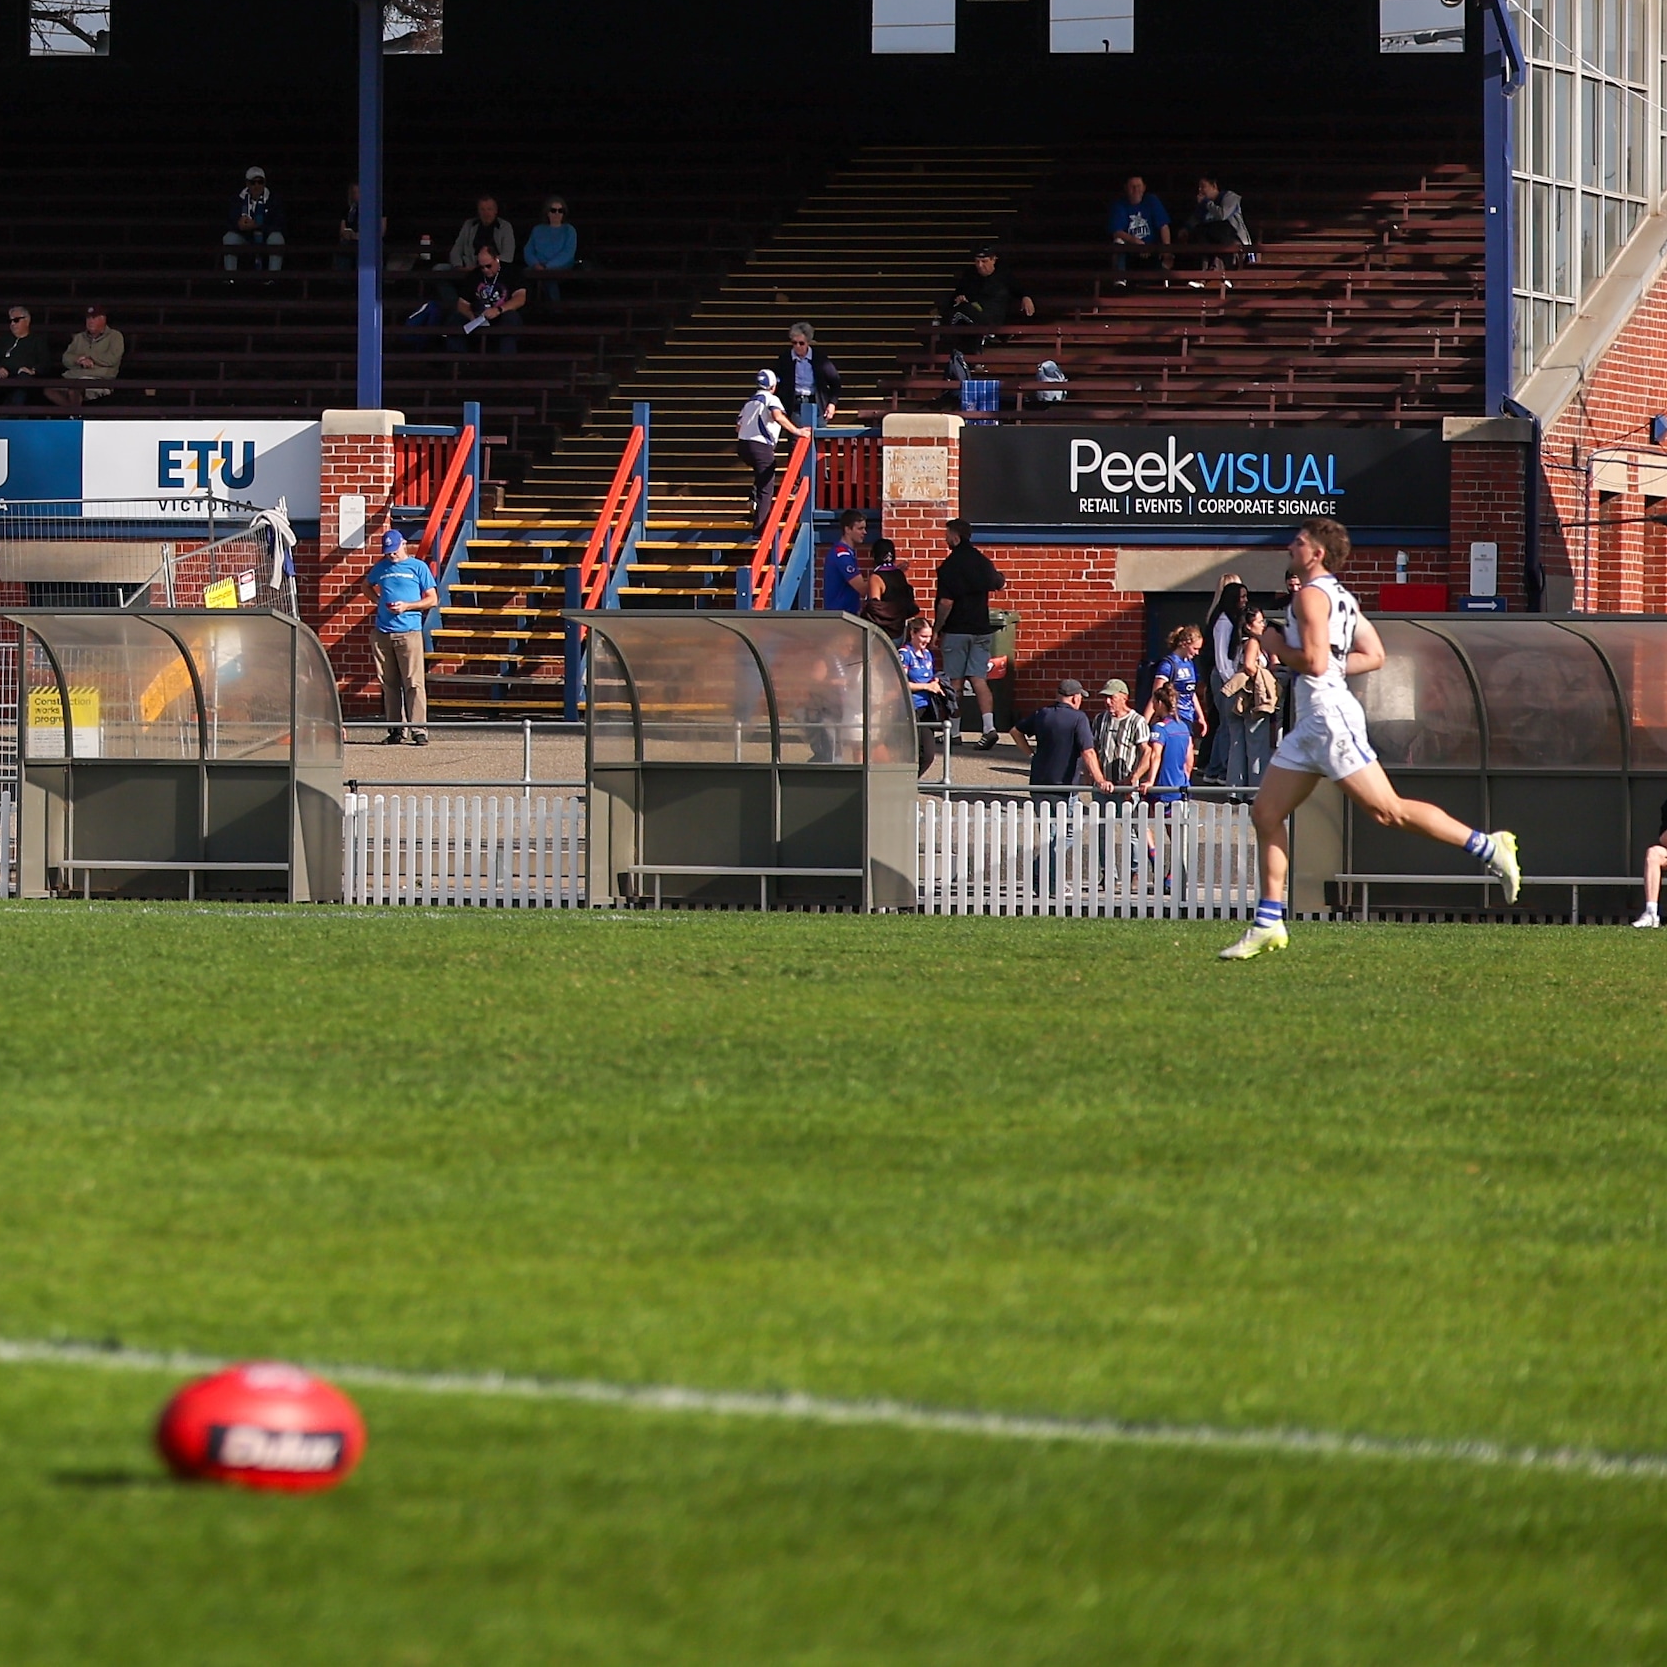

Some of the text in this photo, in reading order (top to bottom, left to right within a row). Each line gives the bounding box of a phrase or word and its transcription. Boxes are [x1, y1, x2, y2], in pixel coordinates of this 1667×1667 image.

[157, 440, 255, 489] ETU
[1079, 498, 1336, 515] RETAIL EVENTS CORPORATE SIGNAGE
[34, 697, 91, 706] Constction
